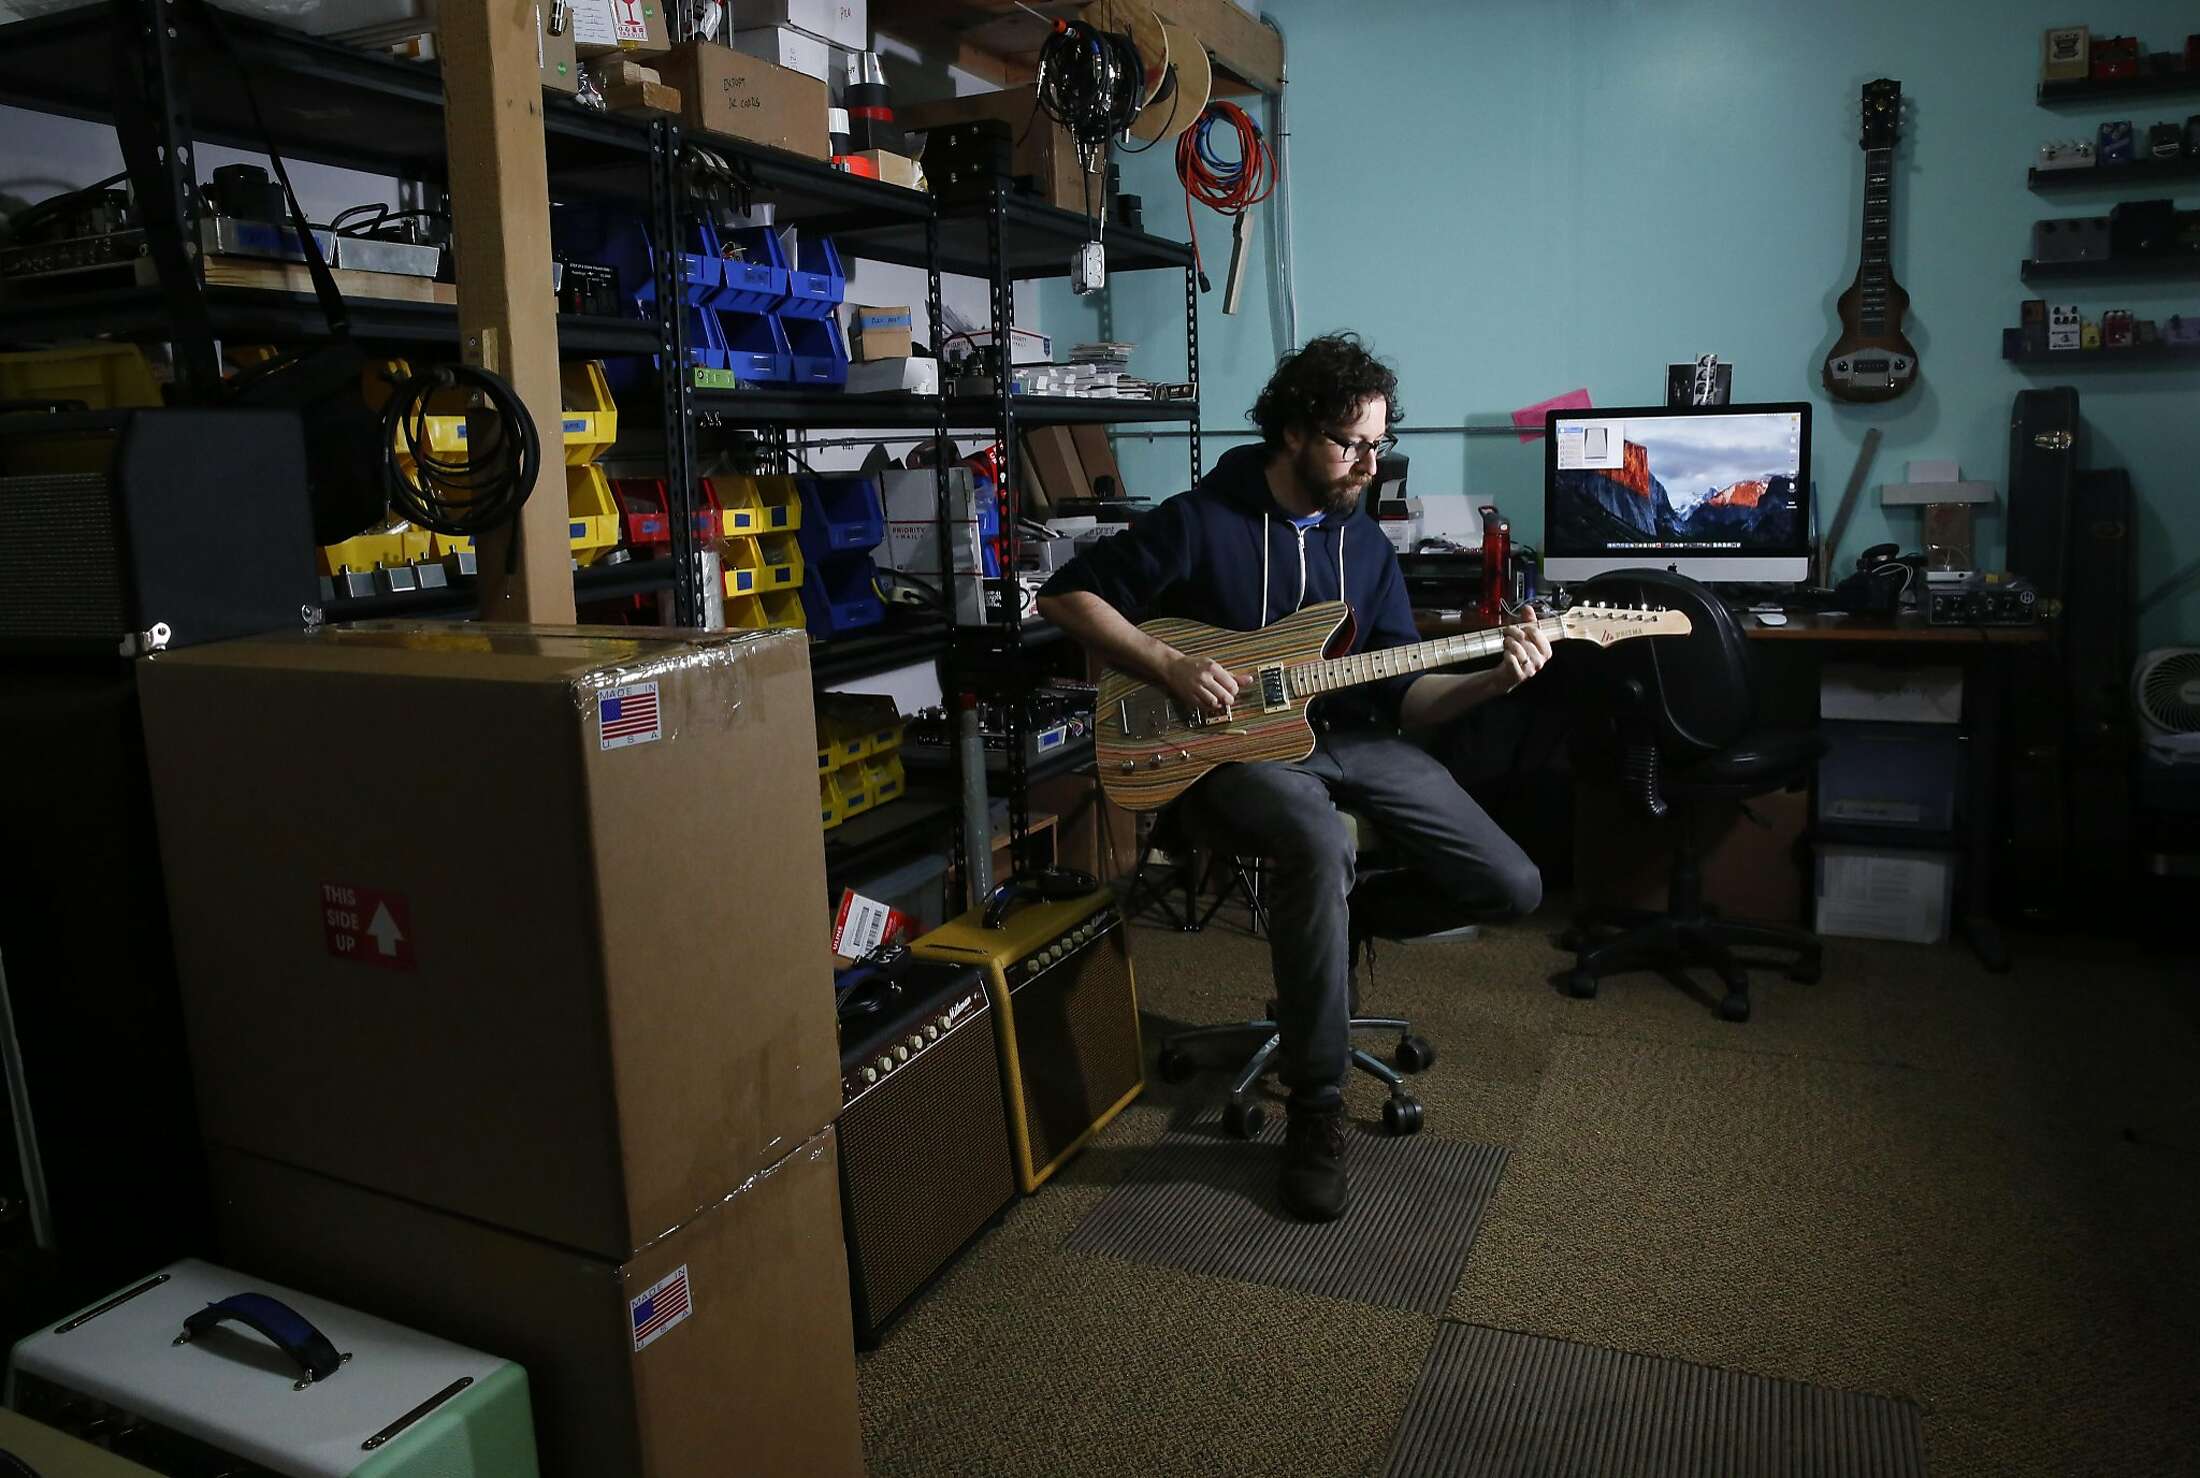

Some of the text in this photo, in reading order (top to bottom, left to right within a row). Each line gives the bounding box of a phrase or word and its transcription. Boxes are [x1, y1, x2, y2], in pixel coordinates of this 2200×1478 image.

[600, 683, 656, 699] MADE IN
[323, 885, 356, 905] THIS
[327, 909, 359, 930] SIDE
[336, 934, 356, 953] UP
[632, 1268, 685, 1308] MADE IN
